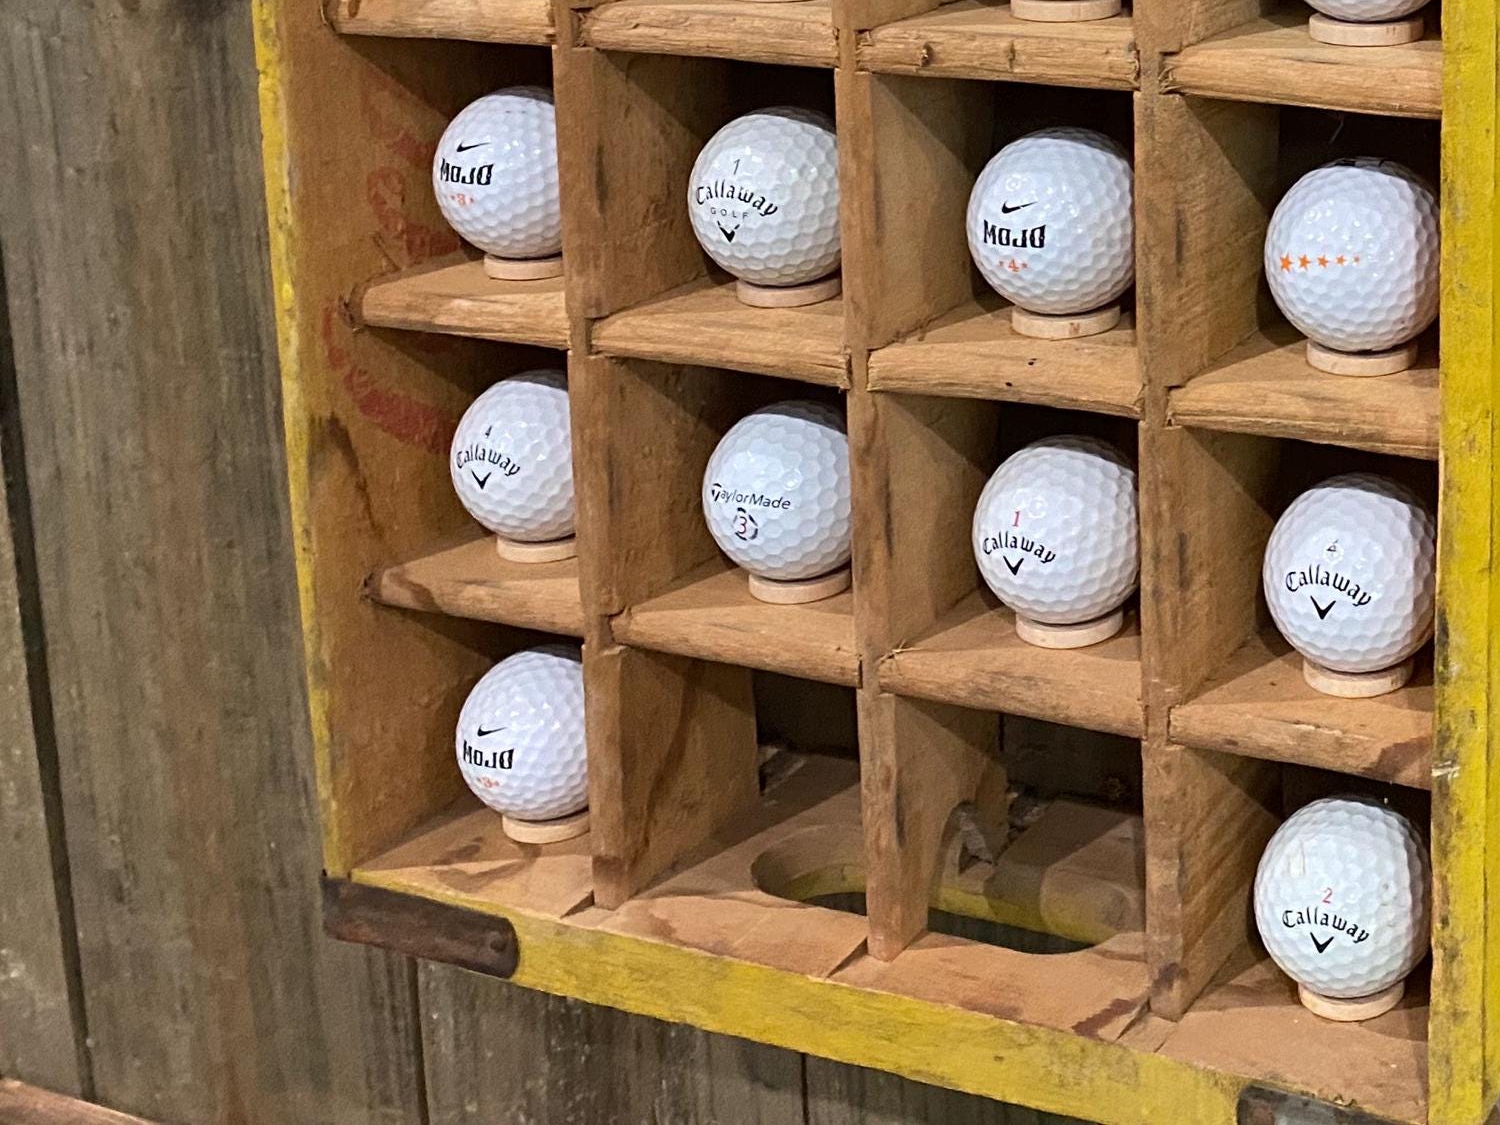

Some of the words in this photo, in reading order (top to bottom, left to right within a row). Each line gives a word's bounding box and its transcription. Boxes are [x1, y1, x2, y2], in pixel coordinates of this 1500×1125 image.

[440, 158, 495, 185] MOJO
[696, 178, 778, 217] Callaway
[710, 207, 749, 223] GOLF
[984, 219, 1046, 249] MOJO
[456, 443, 520, 477] Callaway
[711, 482, 791, 509] TaylorMade
[739, 516, 748, 535] 3
[1012, 510, 1021, 527] 1
[983, 531, 1056, 564] Callaway
[1286, 564, 1371, 607] Callaway
[463, 739, 515, 770] MOJO
[1322, 887, 1333, 904] 2
[1282, 906, 1370, 944] Callaway
